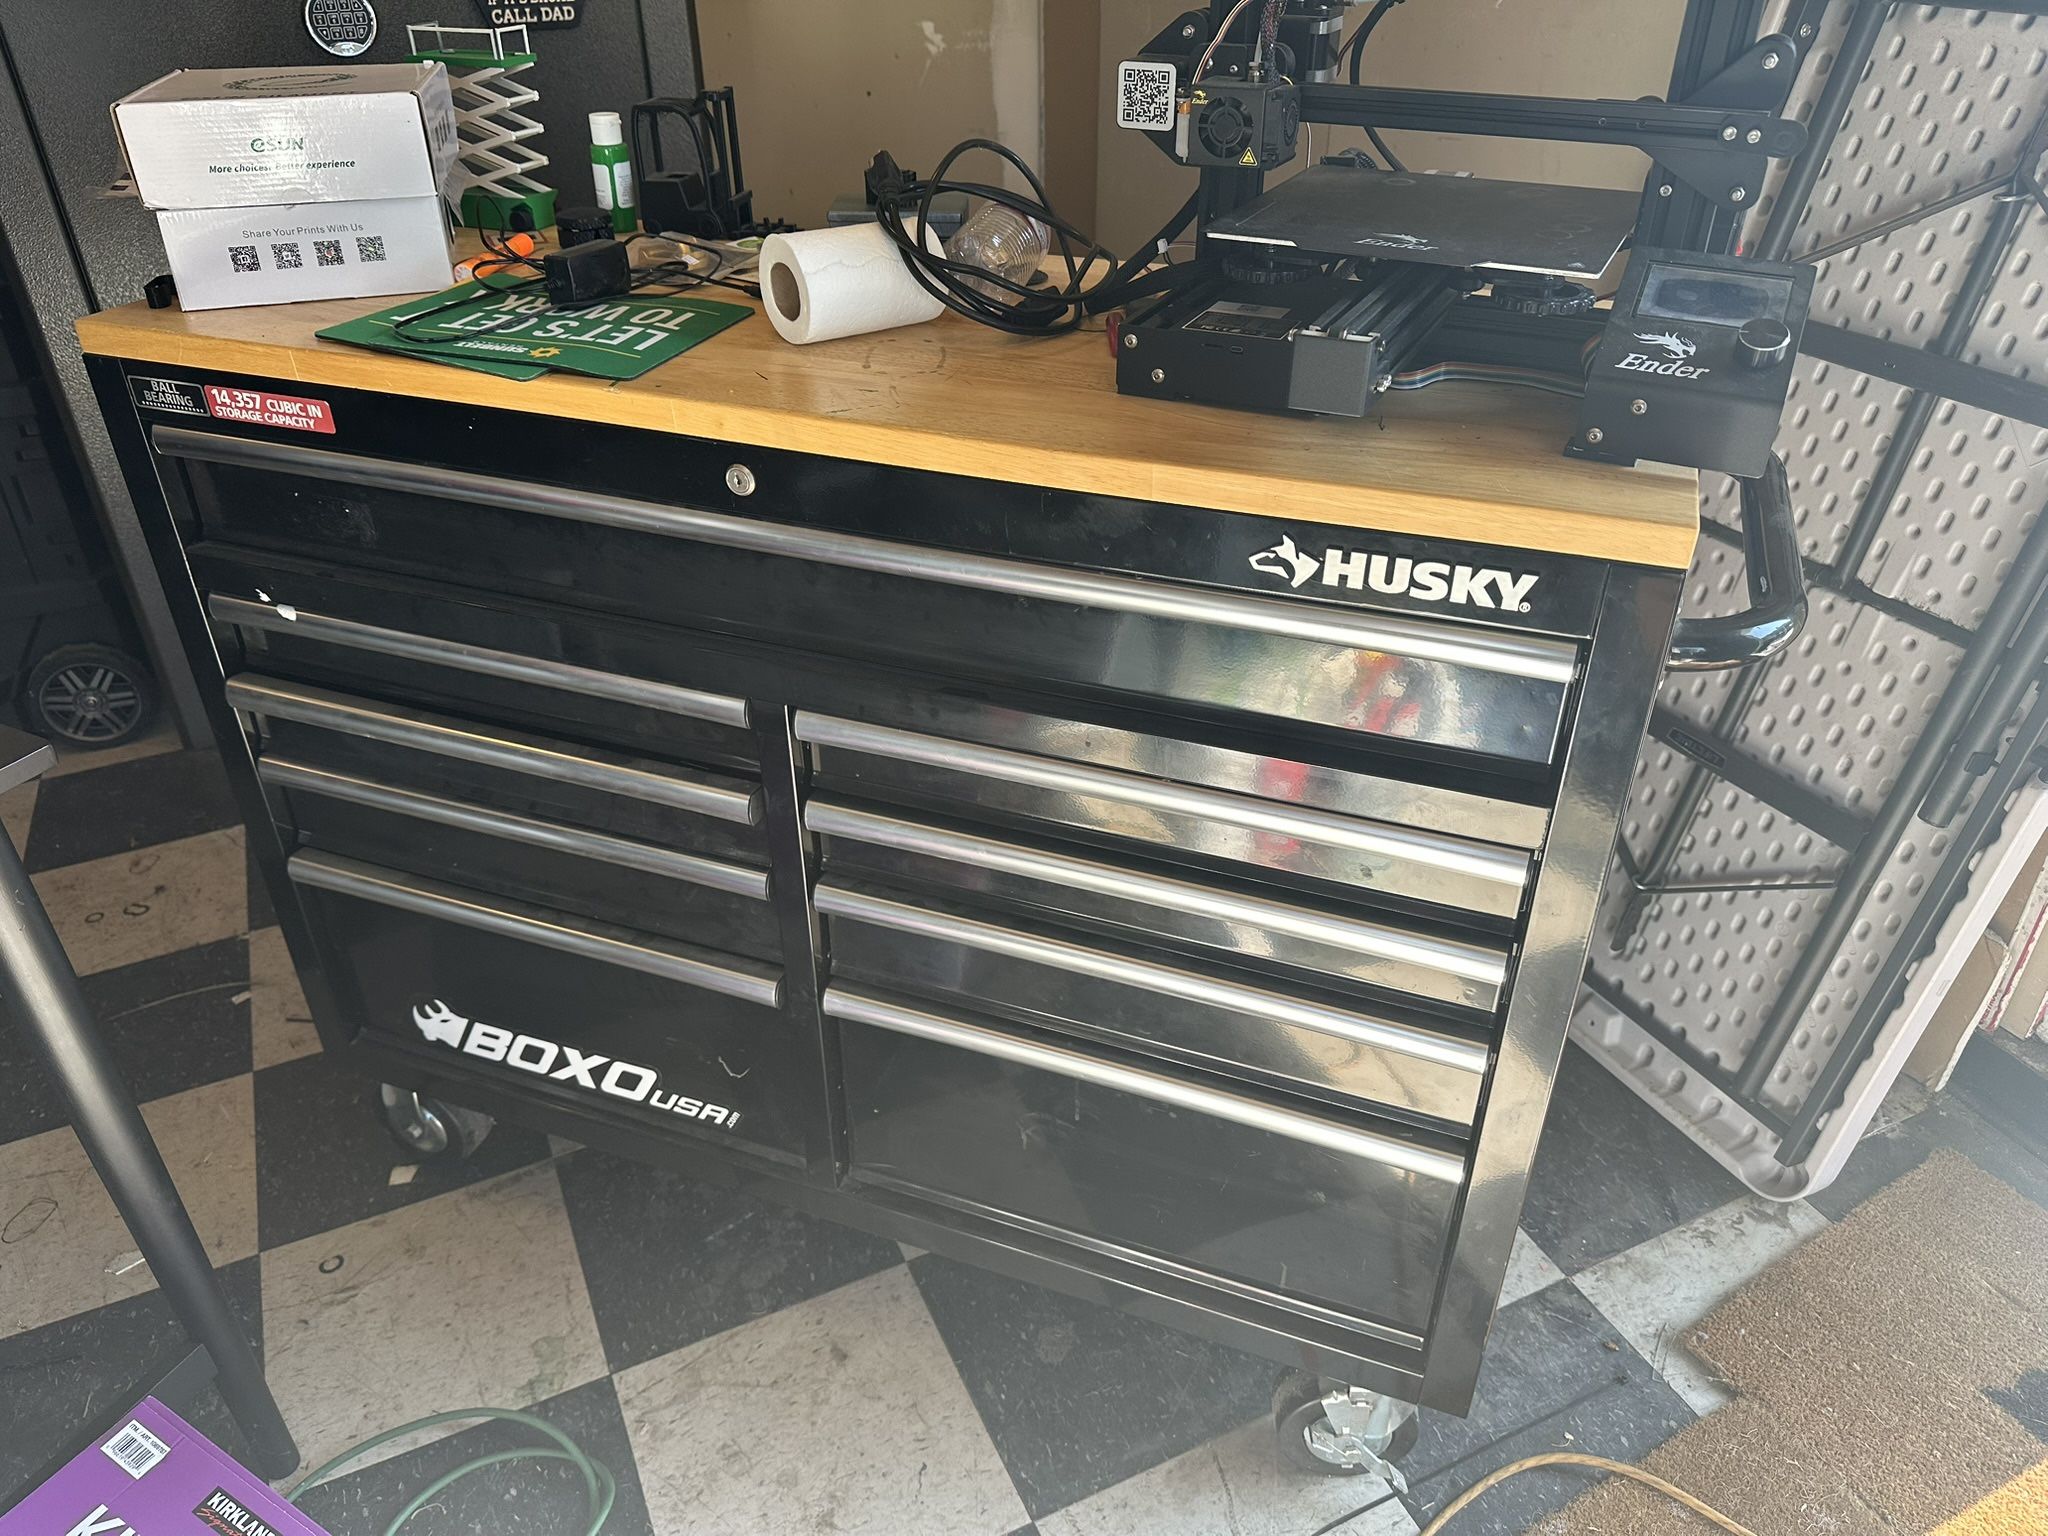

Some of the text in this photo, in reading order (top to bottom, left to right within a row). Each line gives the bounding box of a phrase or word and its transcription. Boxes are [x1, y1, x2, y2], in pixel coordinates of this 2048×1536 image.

[491, 6, 575, 25] CALL DAD
[209, 165, 232, 174] More
[306, 159, 356, 170] experience
[242, 222, 364, 239] Share Your Prints With Us
[1353, 238, 1439, 251] Ender
[629, 308, 696, 331] TO
[1614, 352, 1710, 379] Ender
[143, 390, 193, 407] BEARING
[151, 380, 180, 395] BALL
[211, 388, 323, 419] 14,357 CUBIC IN
[215, 405, 316, 429] STORAGE CAPACITY
[1322, 548, 1540, 612] HUSKY
[462, 1021, 658, 1102] BOXO
[206, 1491, 278, 1536] KIRKLAN
